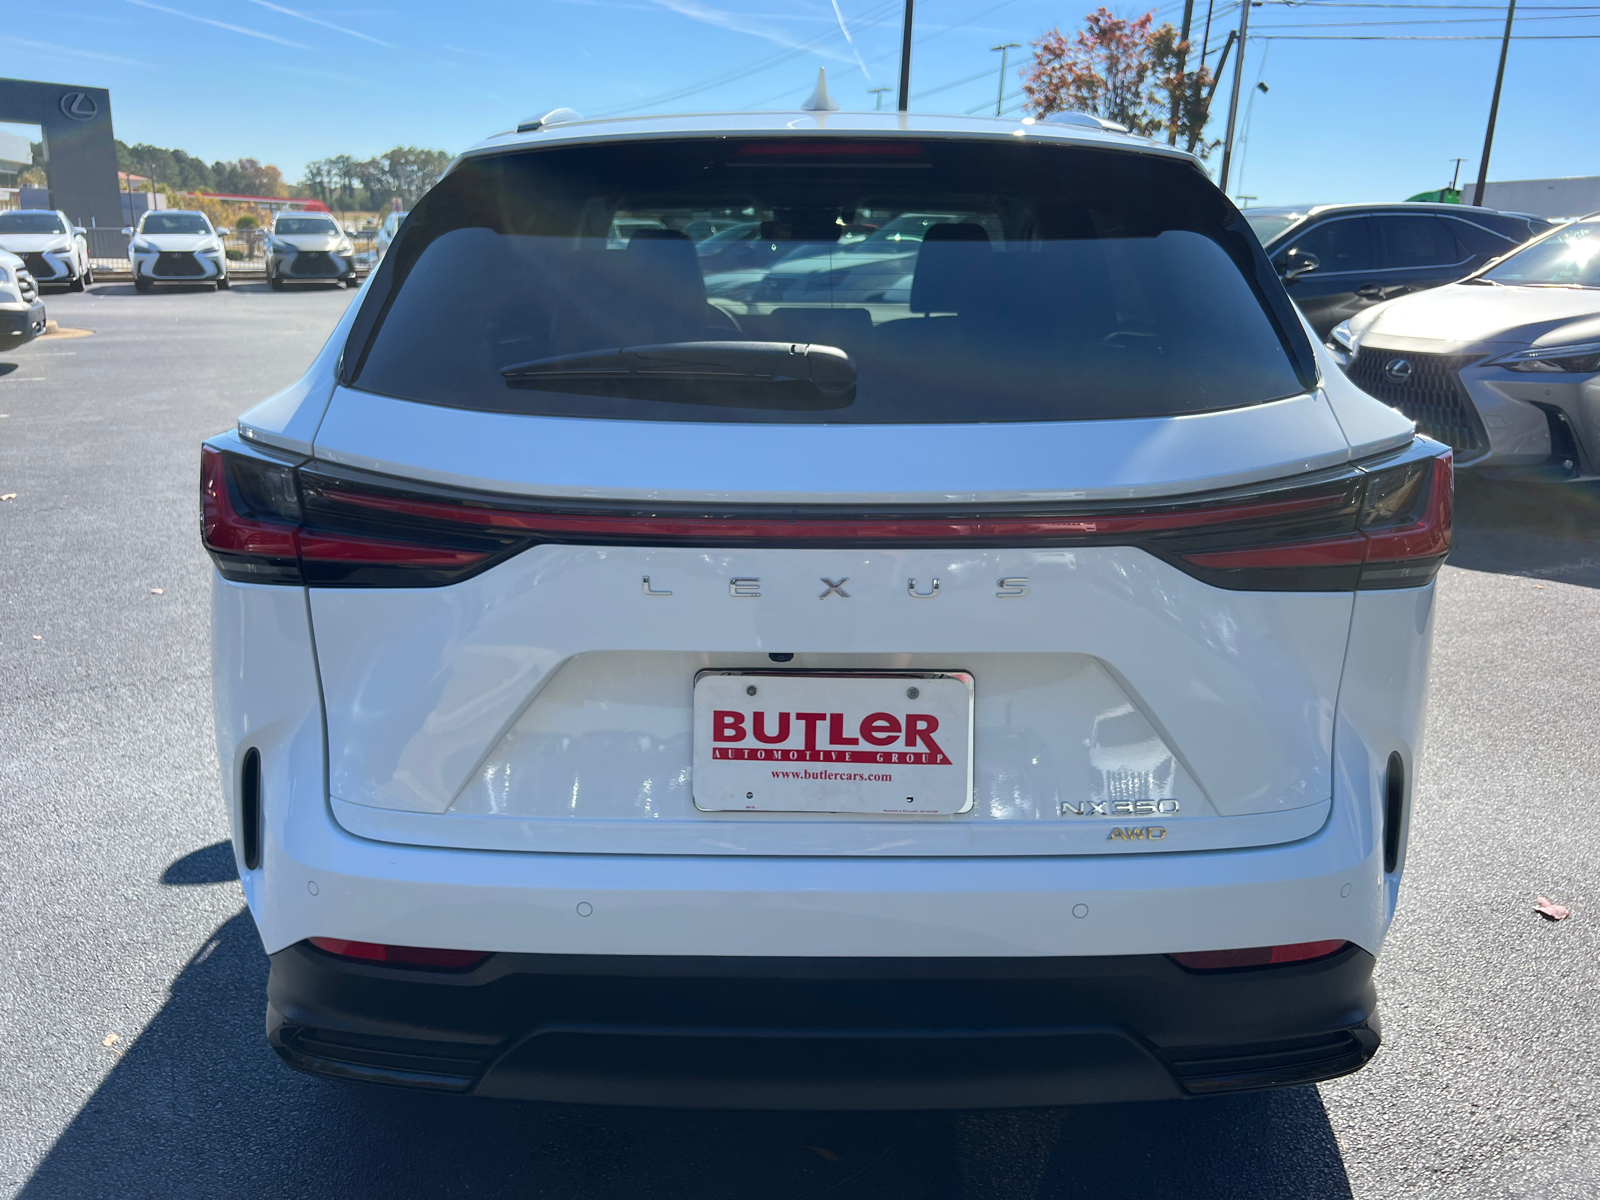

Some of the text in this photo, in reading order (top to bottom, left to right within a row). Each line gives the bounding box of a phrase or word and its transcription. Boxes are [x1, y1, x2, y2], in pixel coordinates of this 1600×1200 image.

[641, 575, 1030, 600] LEXUS
[713, 748, 944, 764] AUTOMOTIVE GROUP
[771, 769, 893, 782] www.butlercars.com
[1107, 826, 1167, 841] AWD
